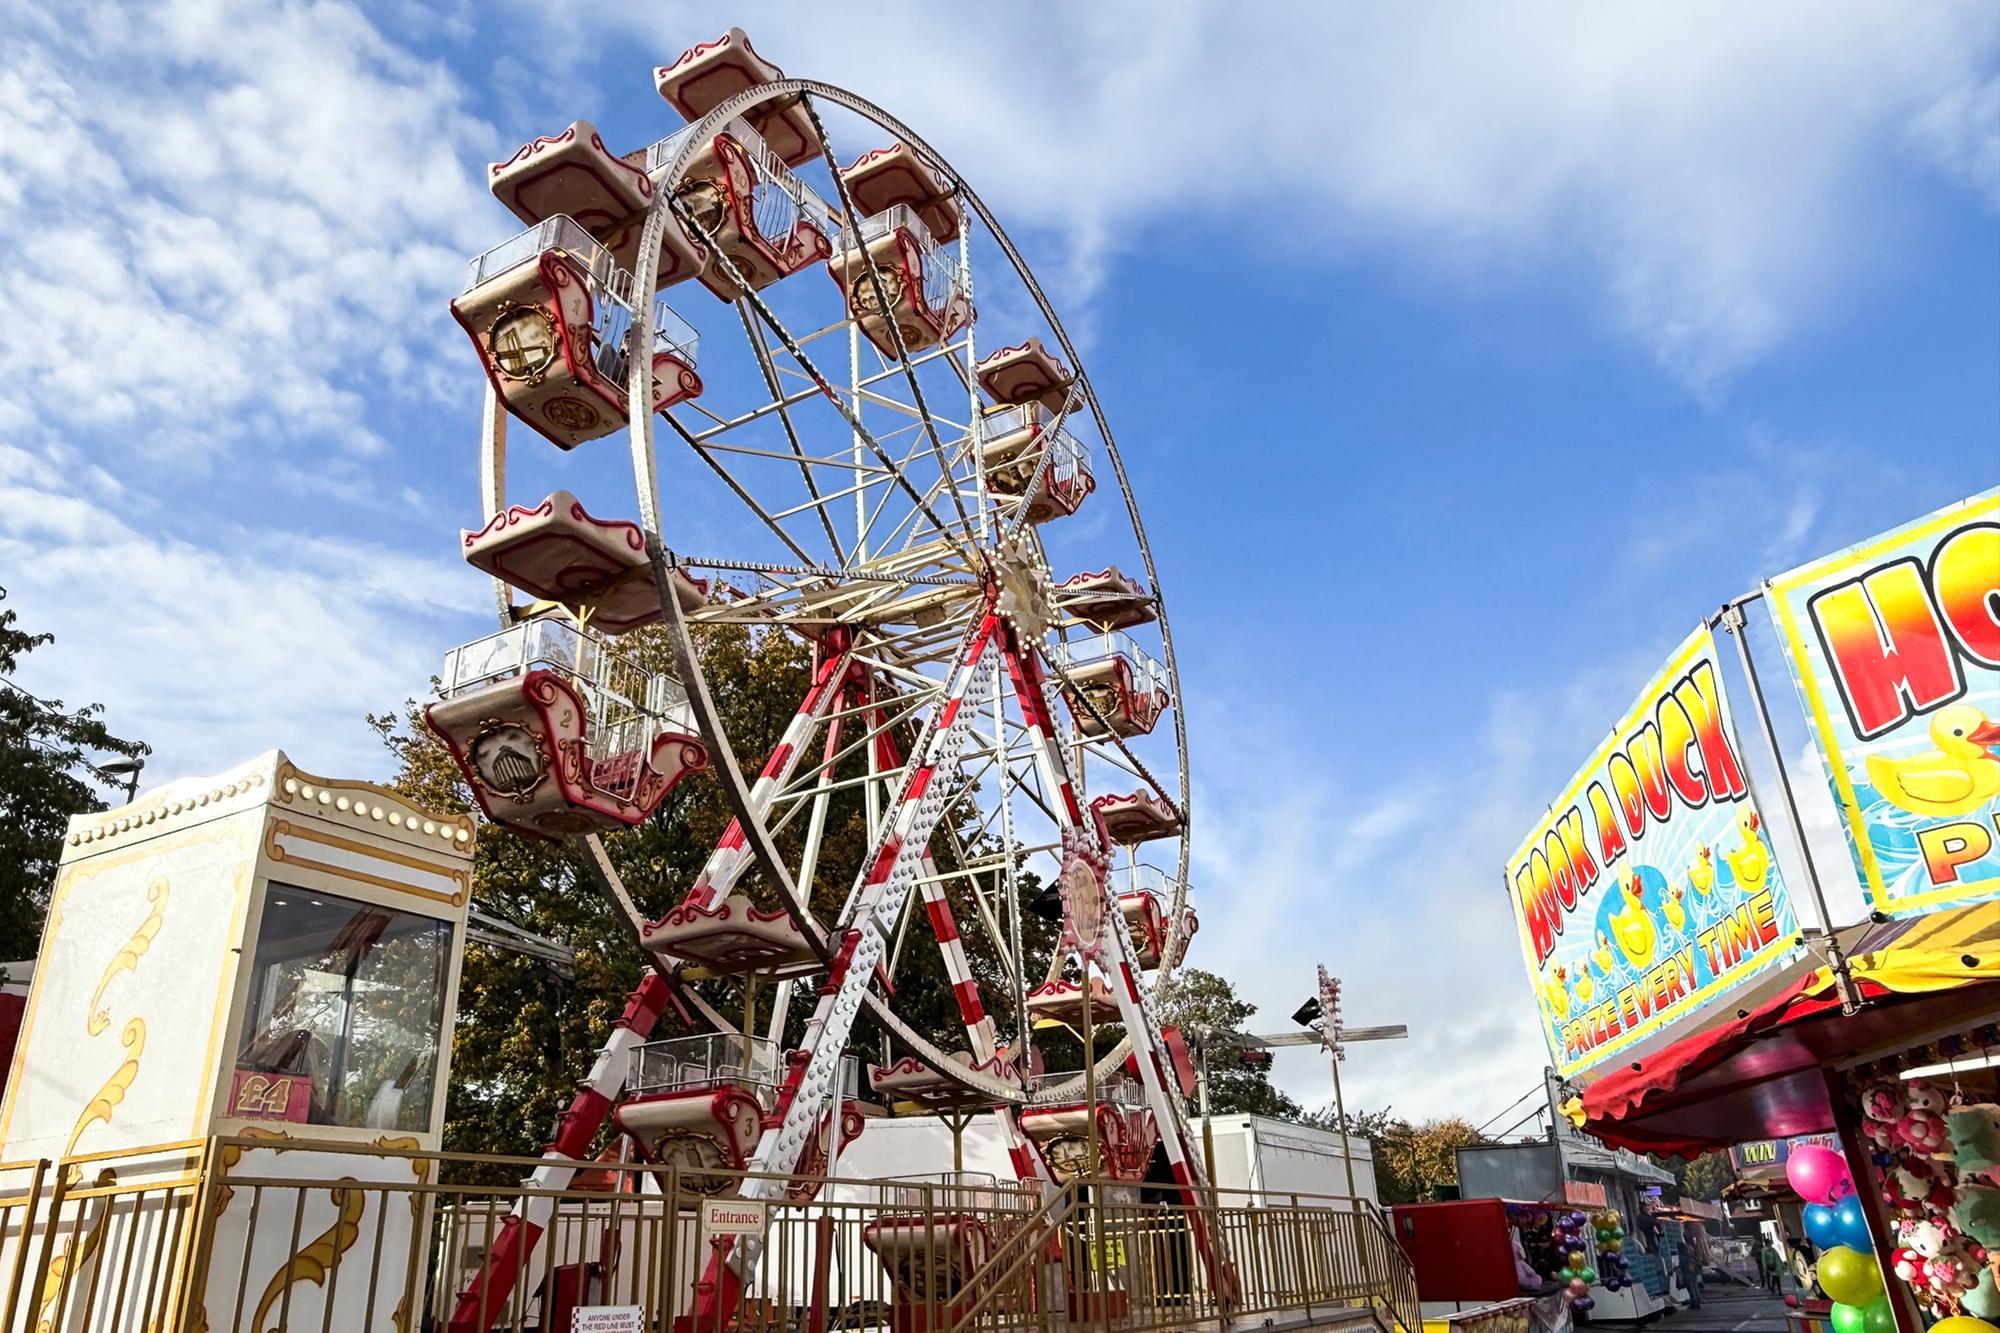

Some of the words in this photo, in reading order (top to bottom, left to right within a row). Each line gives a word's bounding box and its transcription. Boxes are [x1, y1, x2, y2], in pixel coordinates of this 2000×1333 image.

[560, 709, 573, 728] 2
[1516, 805, 1599, 971] HOOK
[1587, 780, 1627, 868] A
[1607, 658, 1748, 841] DUCK
[1916, 812, 2000, 885] P
[1561, 997, 1621, 1060] PRIZE
[1617, 942, 1697, 1030] EVERY
[1697, 888, 1779, 976] TIME
[237, 1075, 293, 1114] £4
[744, 1117, 754, 1137] 3
[1743, 1141, 1776, 1164] WIN
[710, 1208, 759, 1224] Entrance
[582, 1323, 592, 1331] THE
[594, 1322, 606, 1330] RED
[607, 1321, 619, 1330] LINE
[620, 1321, 635, 1329] MUST
[612, 1312, 631, 1321] UNDER
